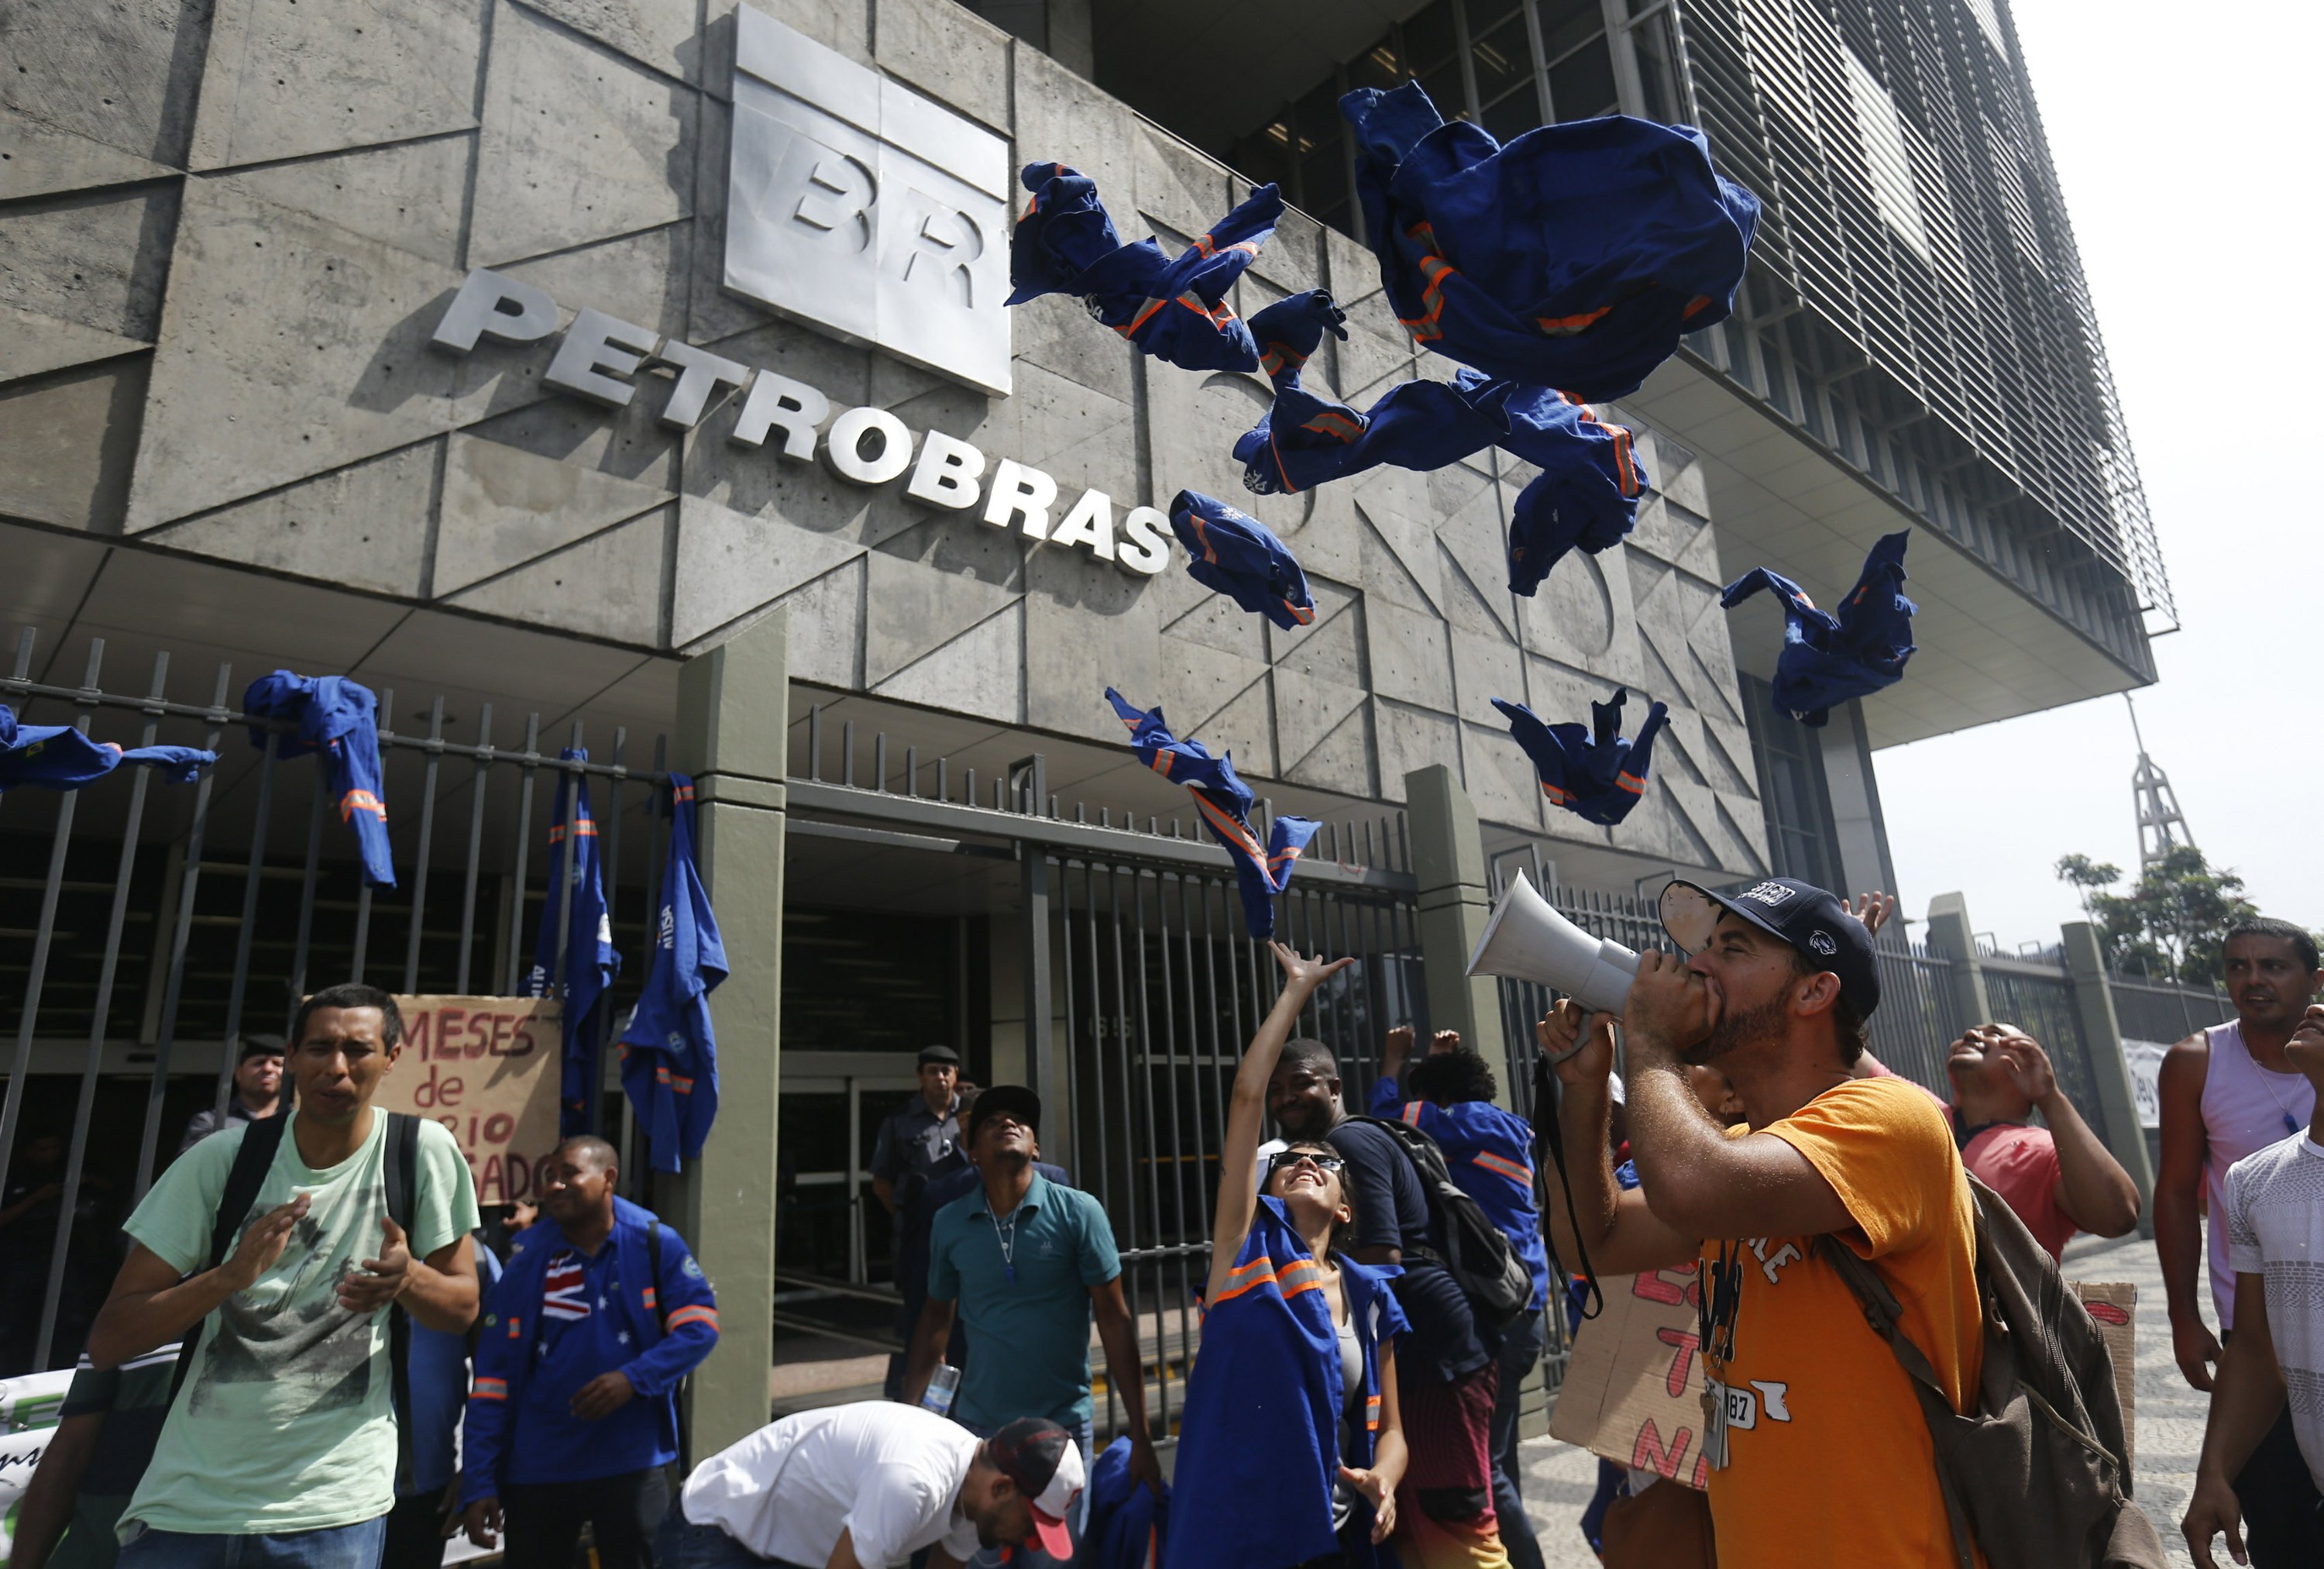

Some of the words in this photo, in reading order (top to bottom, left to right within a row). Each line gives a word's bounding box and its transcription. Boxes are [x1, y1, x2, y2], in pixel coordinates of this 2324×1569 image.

[431, 267, 1174, 578] PETROBRAS
[399, 1006, 538, 1062] MESES
[414, 1065, 464, 1108] de
